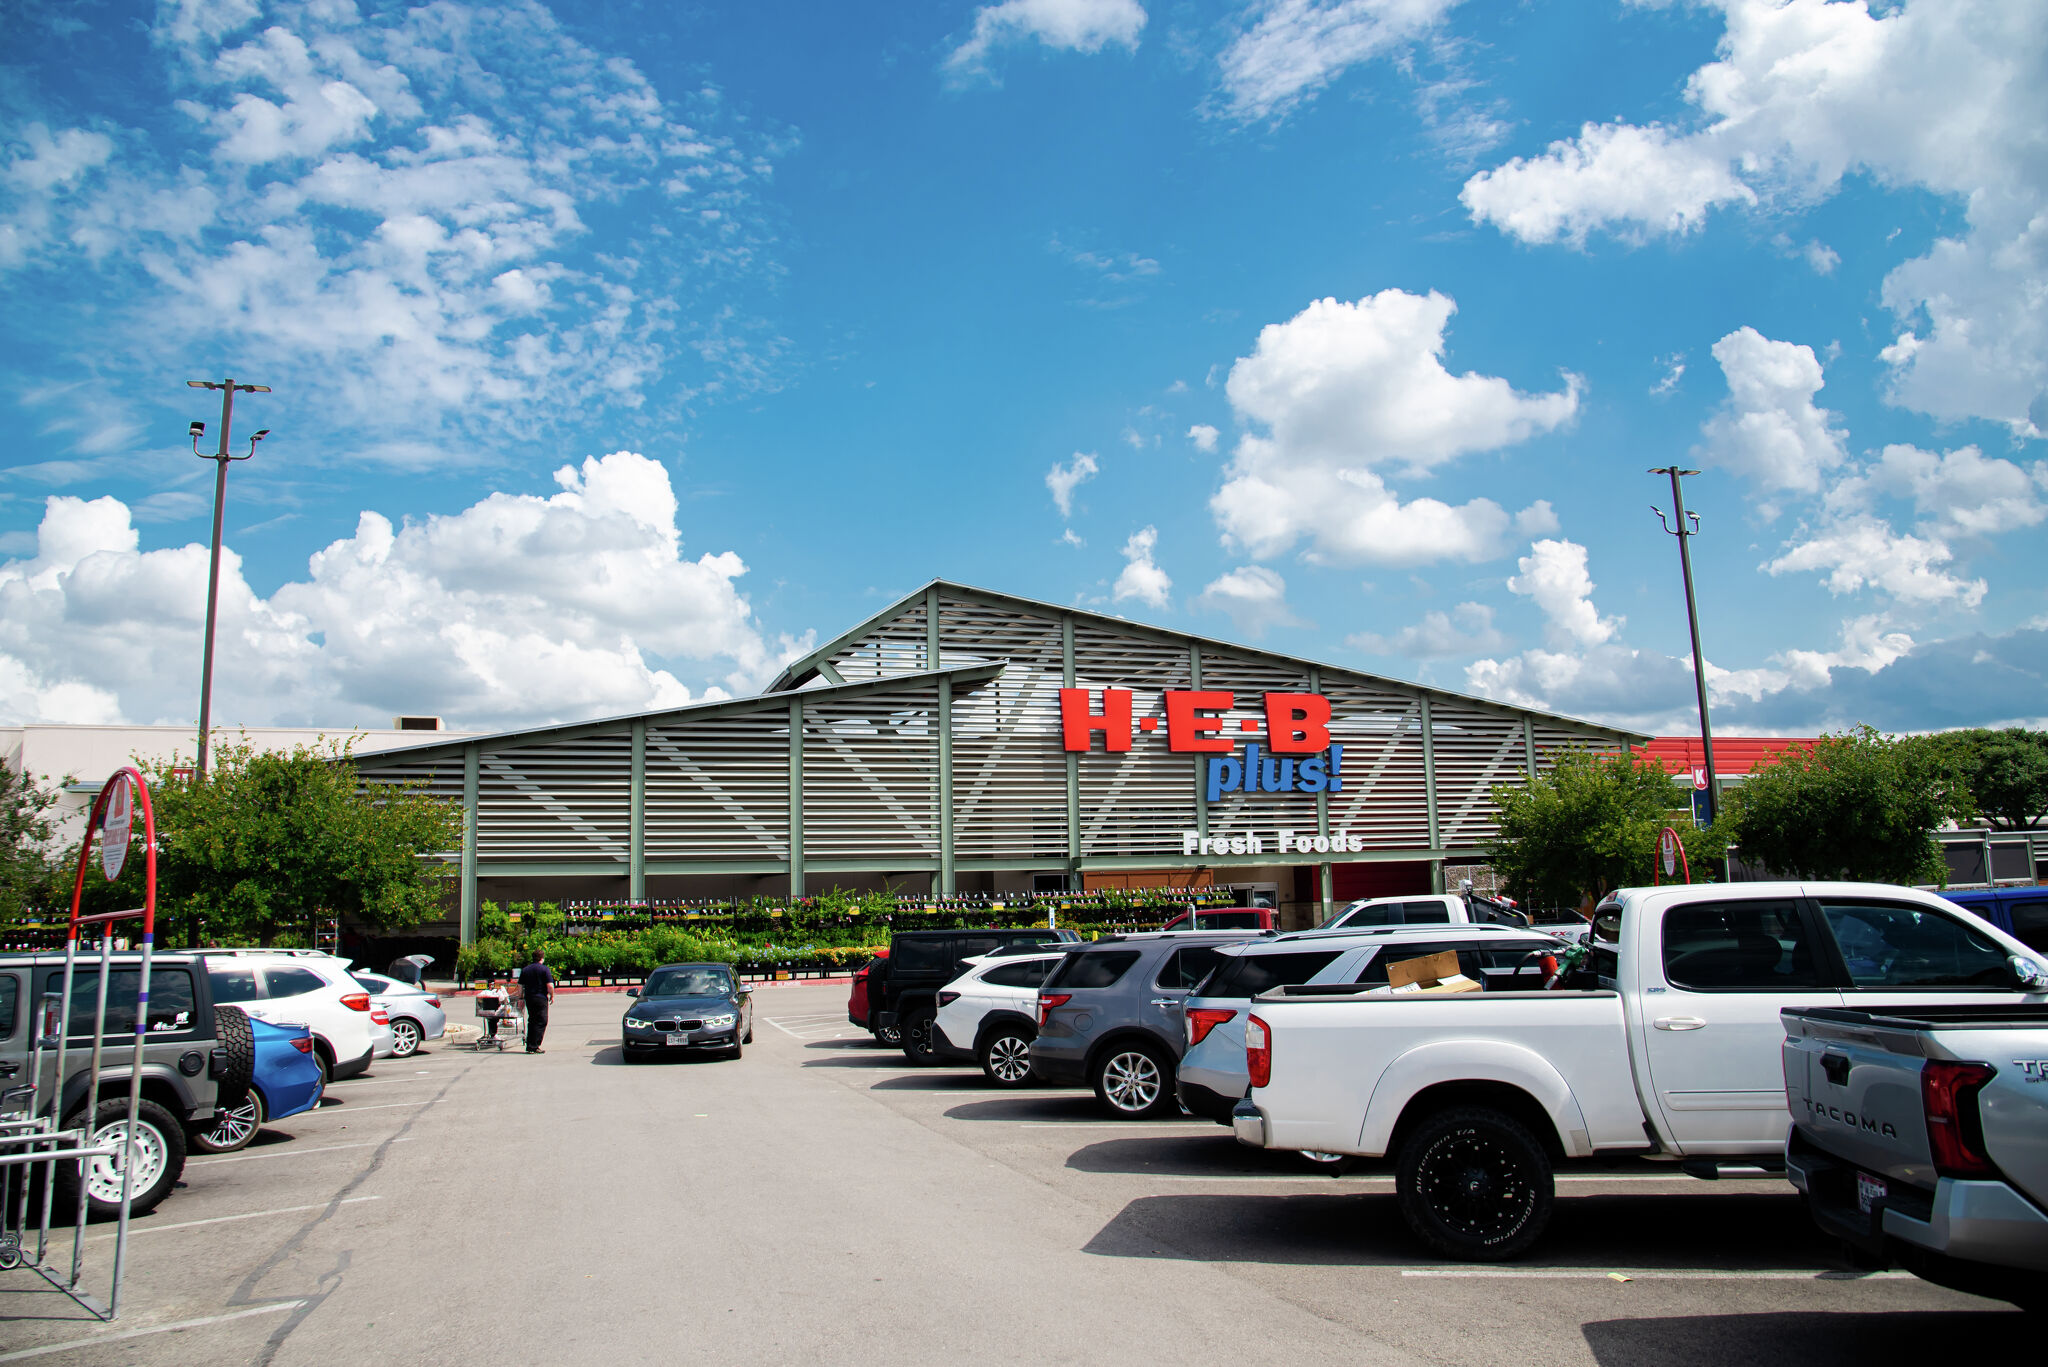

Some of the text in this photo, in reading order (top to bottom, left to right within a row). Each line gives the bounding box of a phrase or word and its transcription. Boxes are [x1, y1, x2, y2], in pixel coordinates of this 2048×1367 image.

[1207, 743, 1344, 801] plus!
[1695, 769, 1706, 785] K
[1183, 828, 1363, 855] Fresh Foods
[1802, 1097, 1897, 1139] TACOMA
[1484, 1189, 1536, 1245] BFGoodrich
